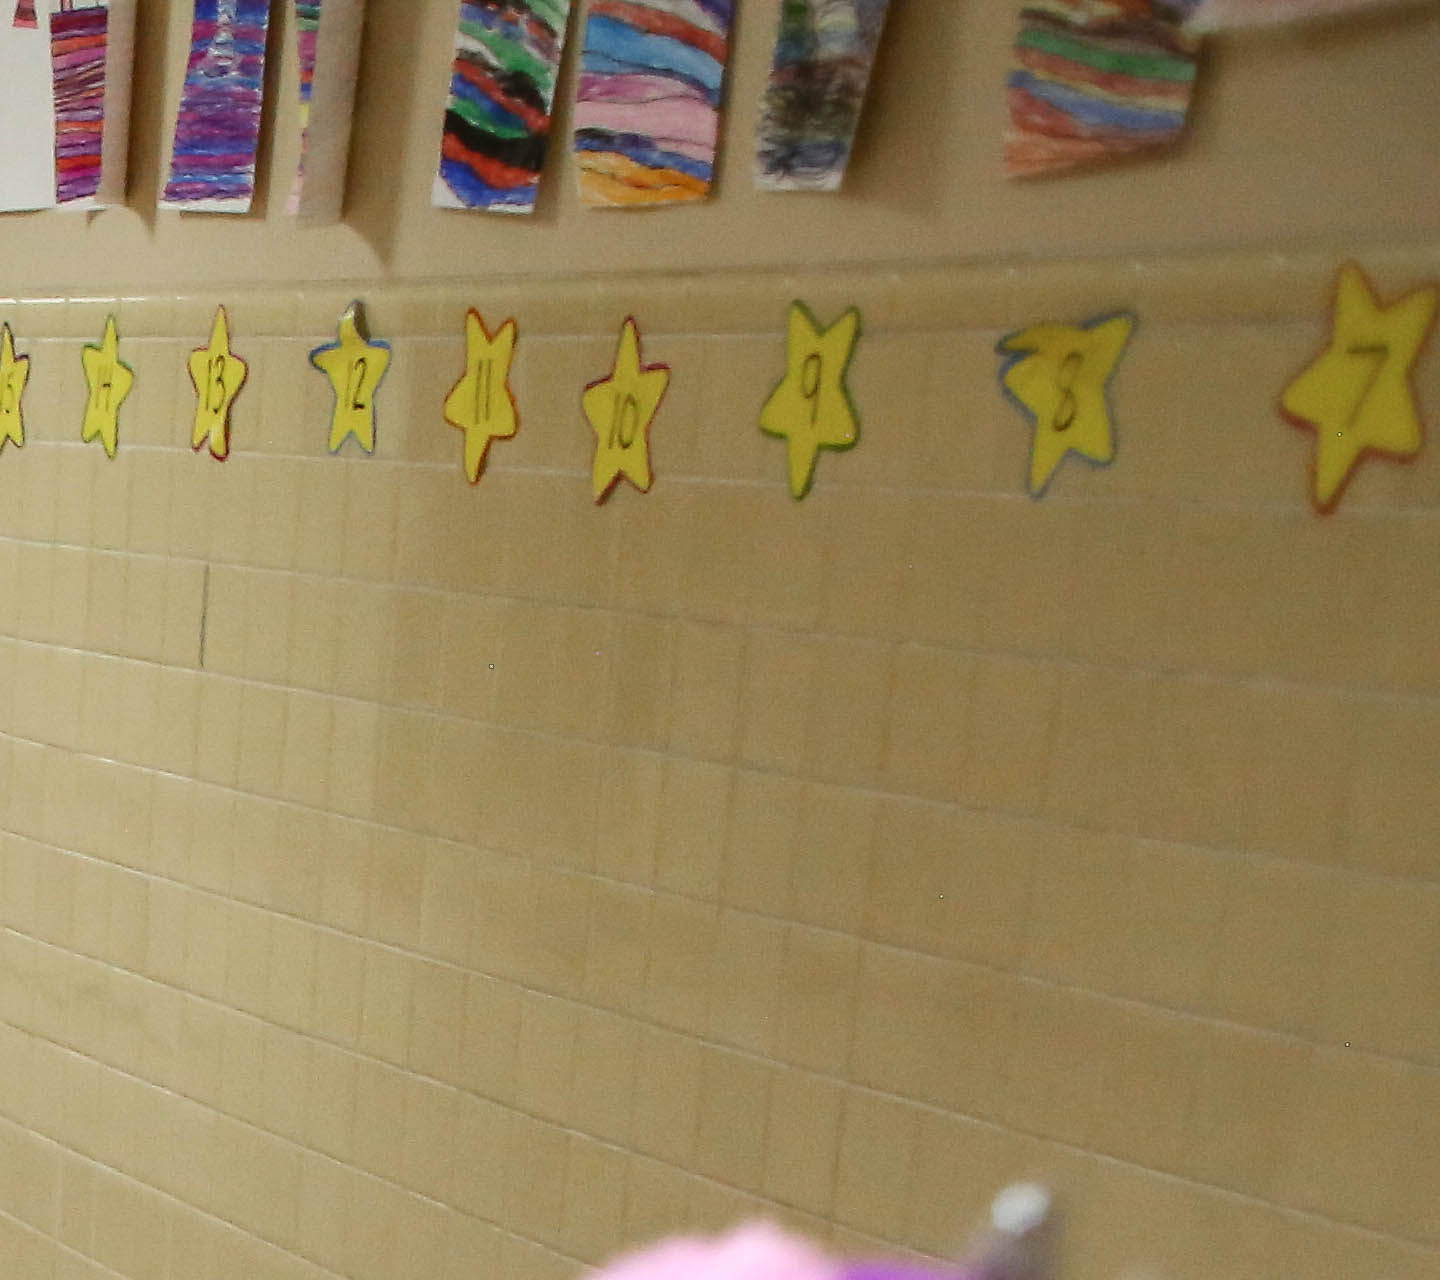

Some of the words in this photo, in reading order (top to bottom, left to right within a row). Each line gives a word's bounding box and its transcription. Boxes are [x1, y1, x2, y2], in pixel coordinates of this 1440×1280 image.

[206, 355, 226, 414] 13
[344, 357, 367, 411] 12
[474, 358, 491, 425] 11
[1053, 351, 1084, 432] 8
[1347, 342, 1389, 432] 7
[608, 392, 639, 450] 10
